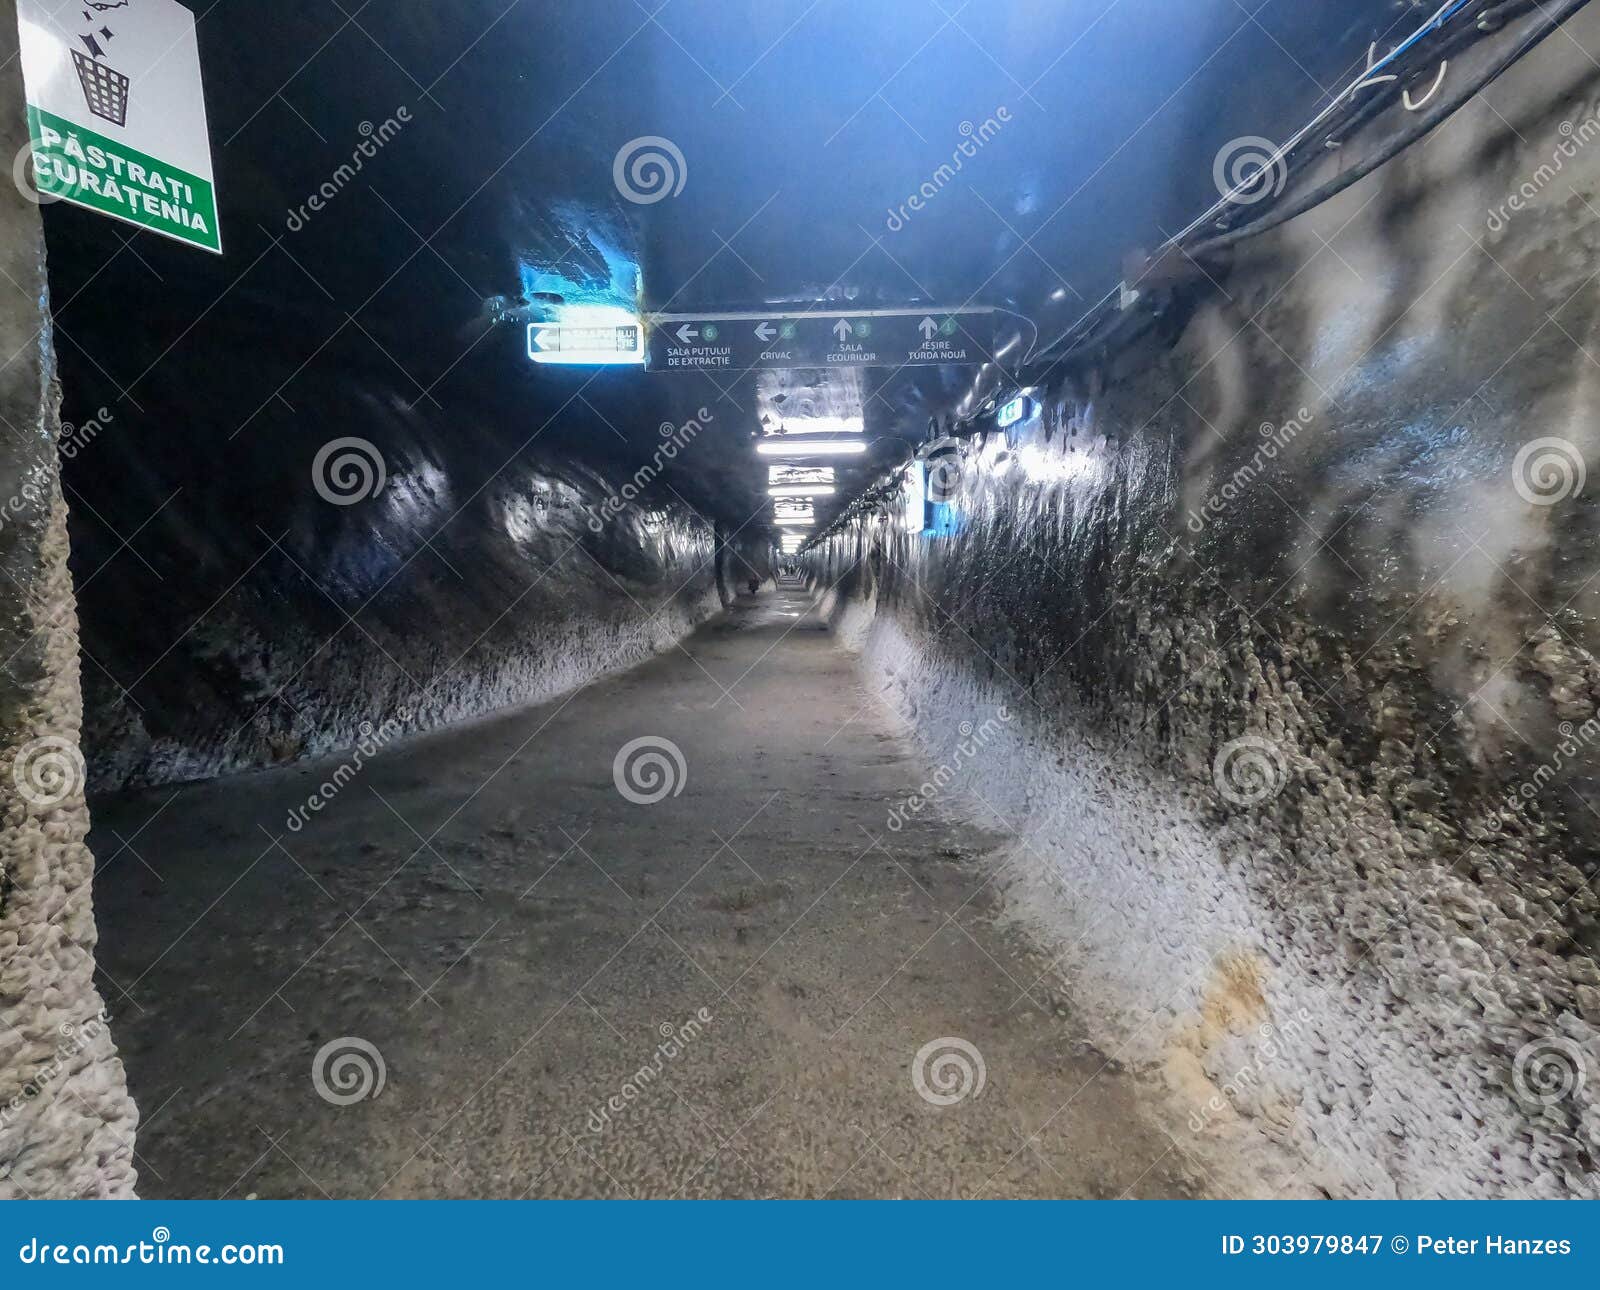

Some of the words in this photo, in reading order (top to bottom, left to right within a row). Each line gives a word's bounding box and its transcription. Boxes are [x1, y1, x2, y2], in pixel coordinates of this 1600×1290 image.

[40, 125, 193, 205] PĂSTRAȚI
[33, 152, 209, 234] CURĂȚENIA
[840, 343, 863, 352] SALA
[667, 348, 690, 357] SALA
[760, 351, 792, 360] CRIVAC
[826, 352, 876, 362] ECOURILOR
[908, 351, 939, 360] TURDA
[668, 357, 680, 366] DE
